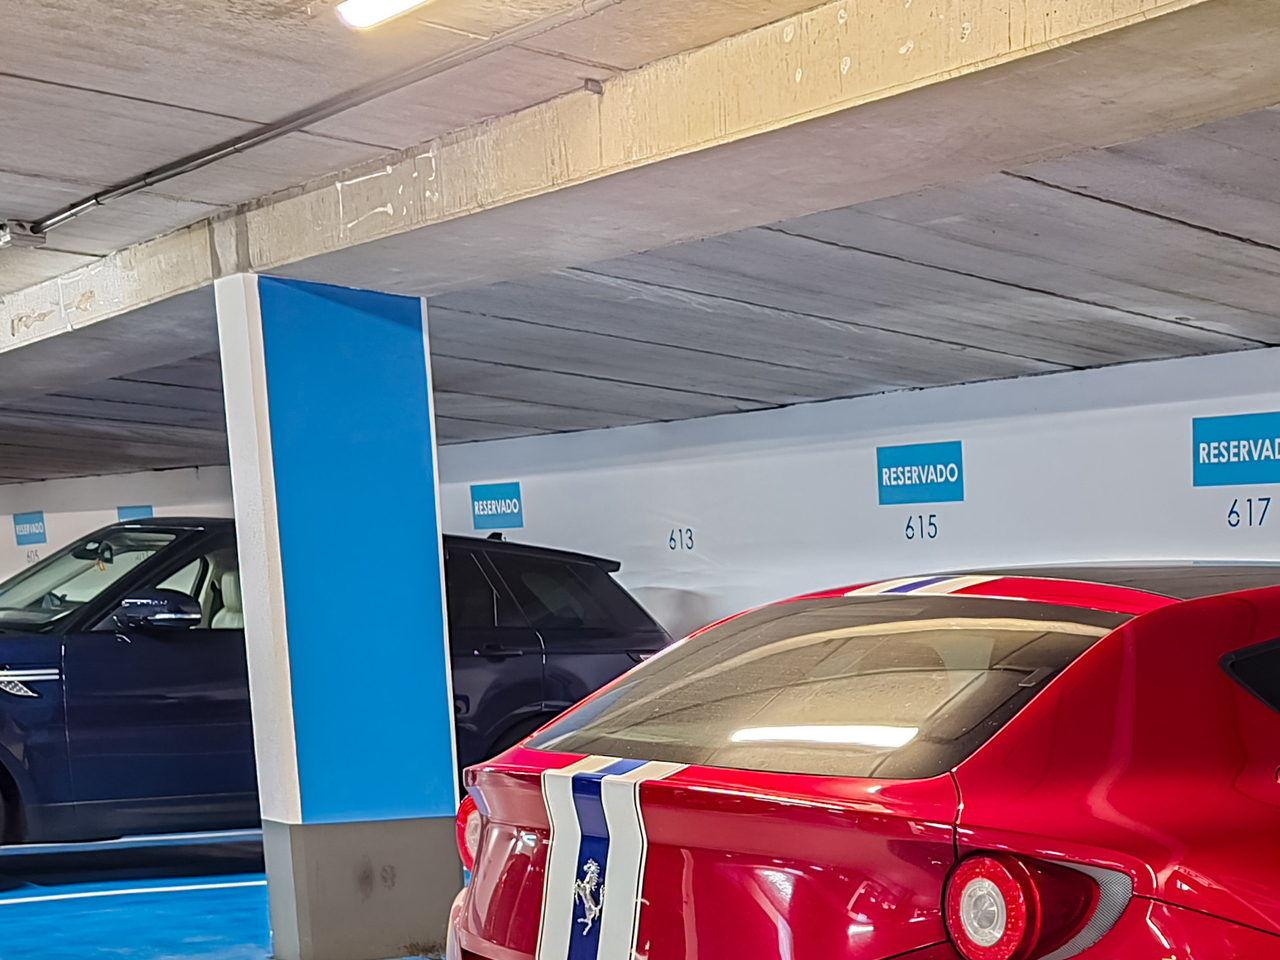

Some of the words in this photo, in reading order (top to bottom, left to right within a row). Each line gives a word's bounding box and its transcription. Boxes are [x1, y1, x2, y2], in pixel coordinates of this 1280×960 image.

[881, 462, 959, 487] RESERVADO
[473, 498, 519, 516] RESERVADO
[1227, 497, 1272, 527] 617
[668, 528, 695, 550] 613
[905, 514, 938, 540] 615
